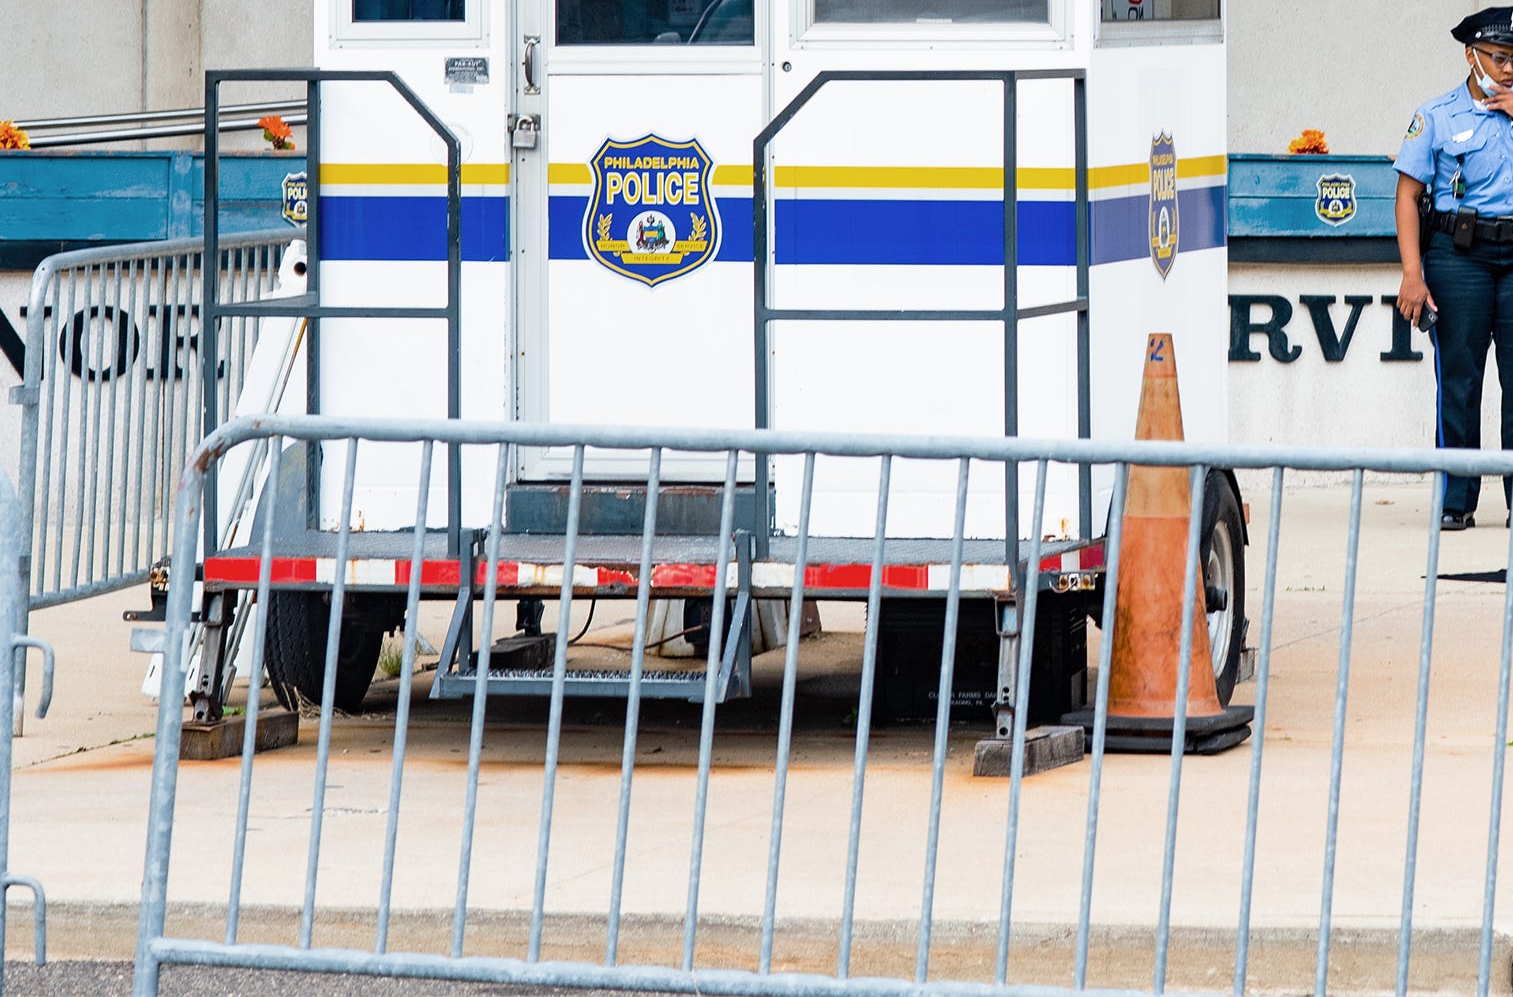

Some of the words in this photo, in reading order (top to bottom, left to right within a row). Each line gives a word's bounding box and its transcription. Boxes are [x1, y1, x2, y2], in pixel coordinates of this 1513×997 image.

[604, 157, 700, 169] PHILADELPHIA
[606, 171, 700, 206] POLICE
[1322, 186, 1350, 199] POLICE
